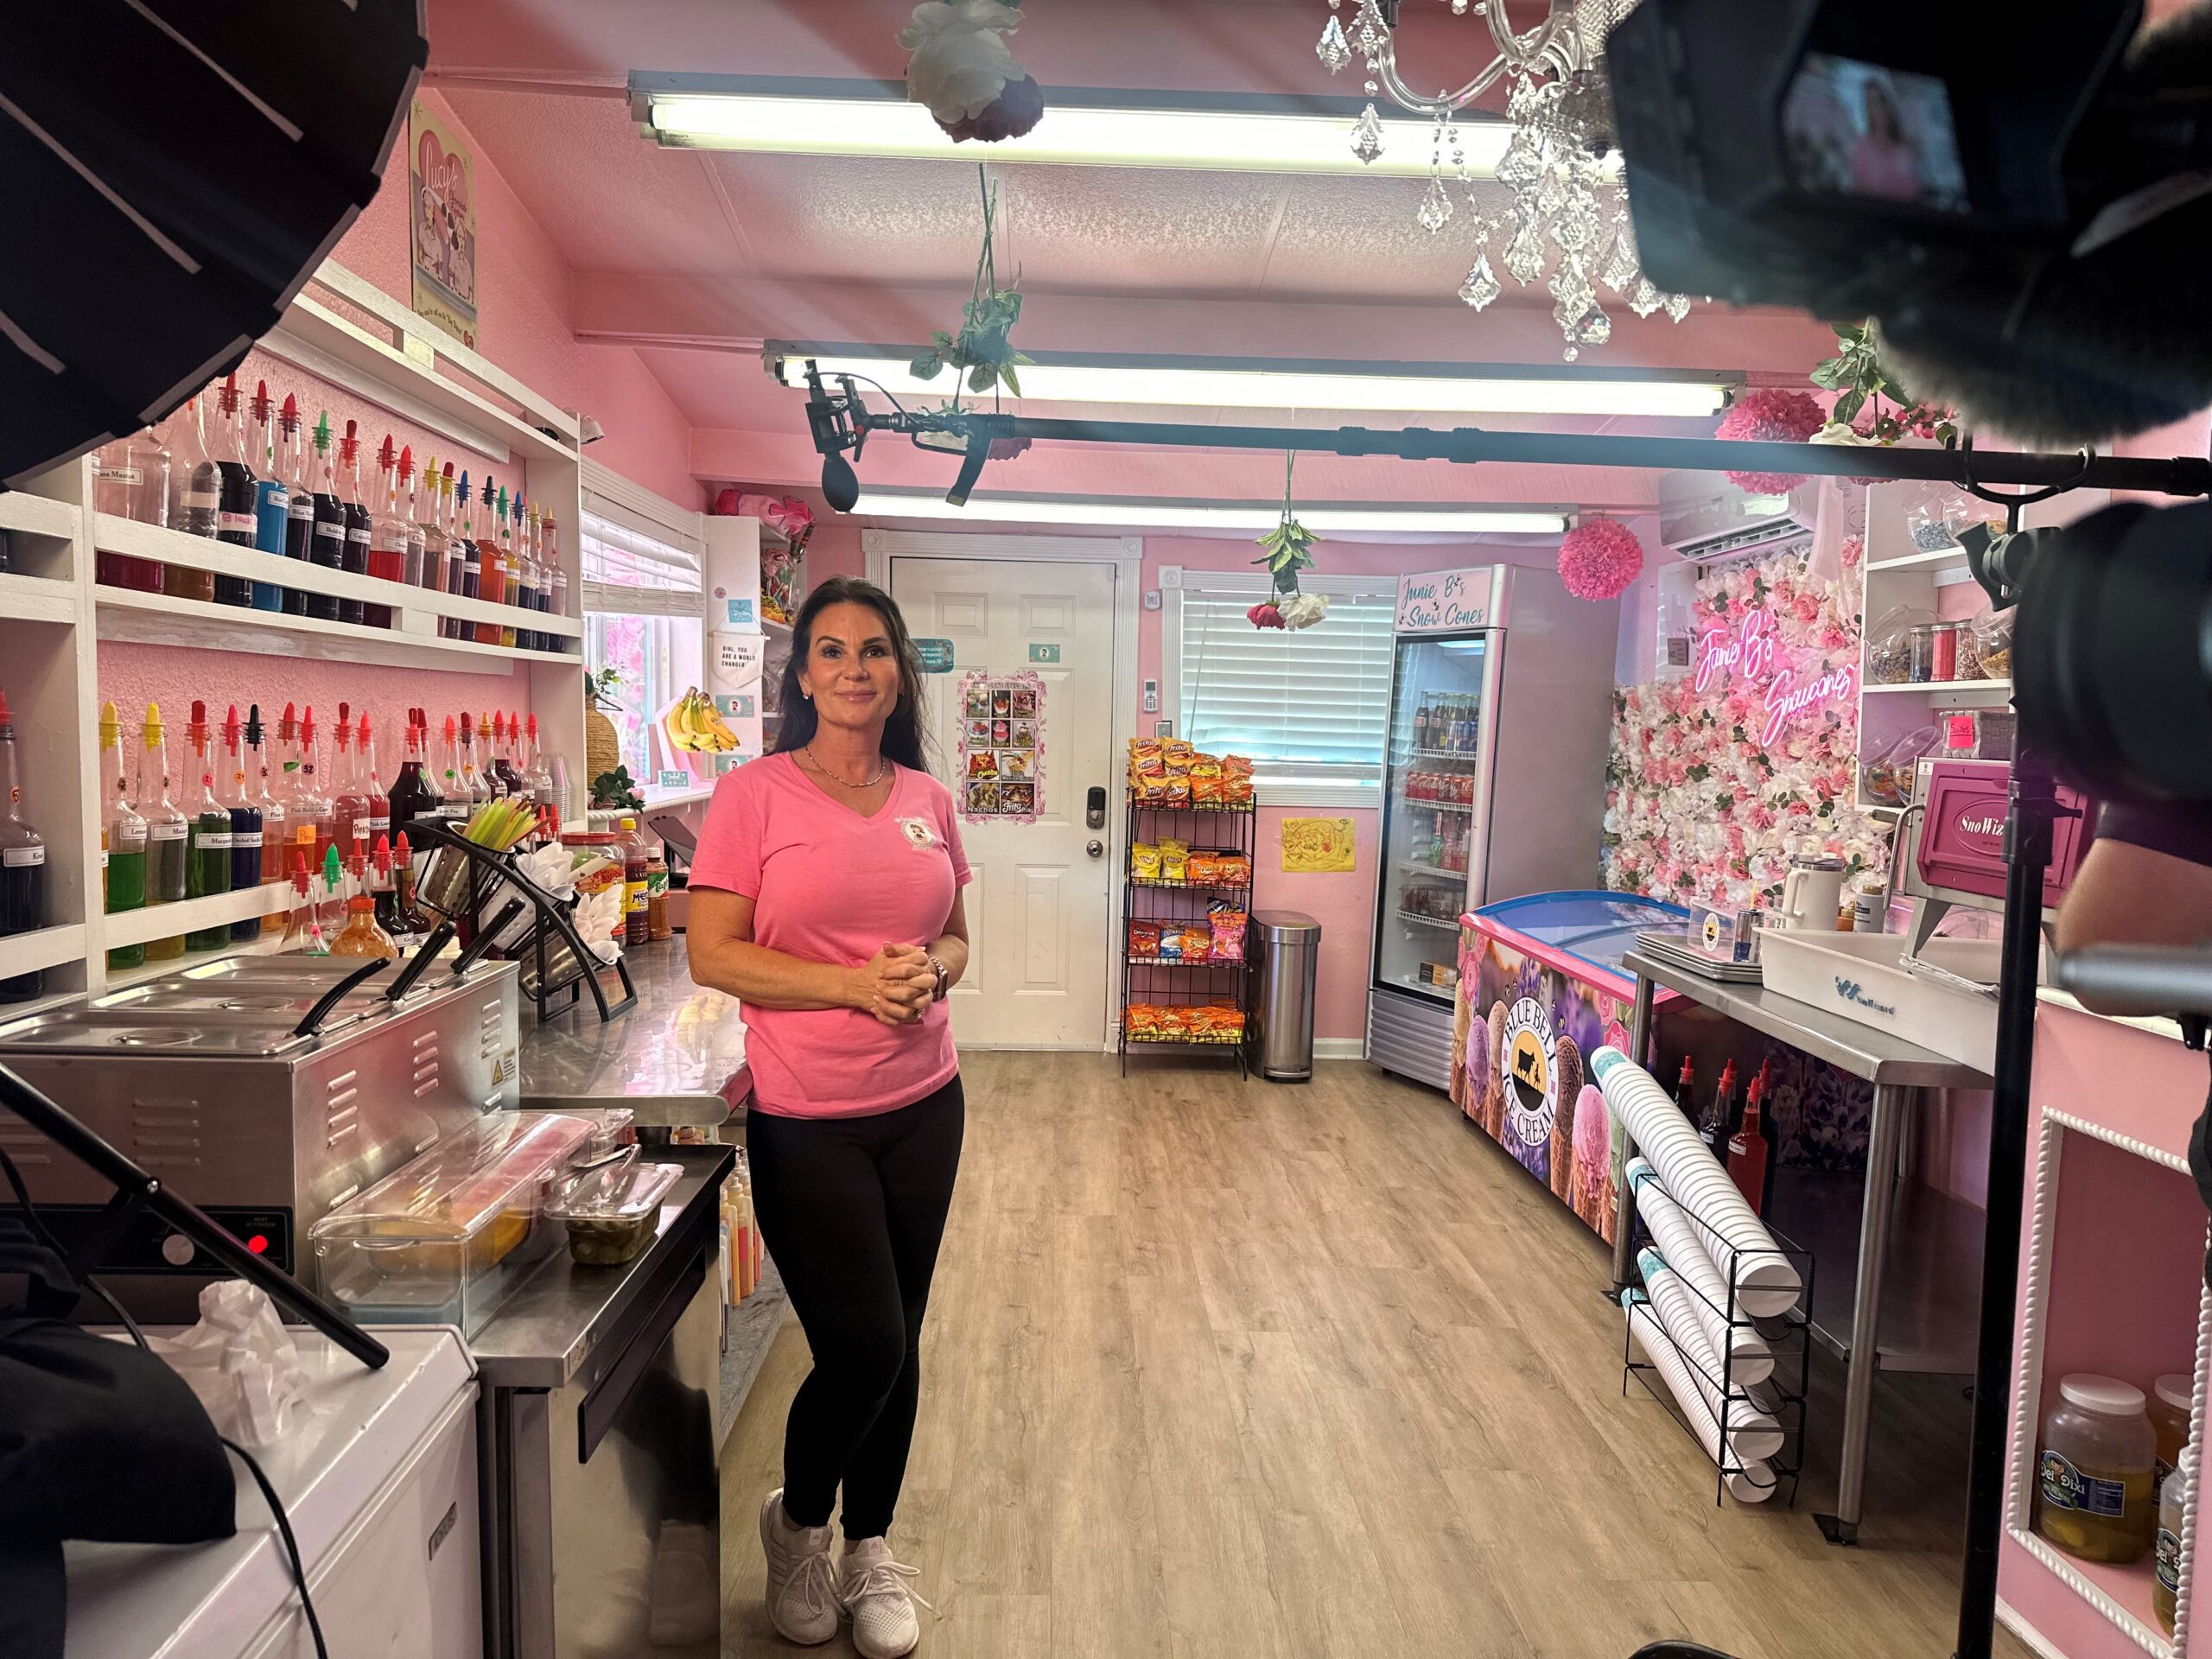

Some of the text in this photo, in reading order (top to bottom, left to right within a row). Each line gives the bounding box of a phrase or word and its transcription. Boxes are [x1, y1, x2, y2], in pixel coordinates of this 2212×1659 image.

[1401, 578, 1437, 610] Junie
[1407, 603, 1484, 626] Snow Cones
[303, 764, 314, 774] 32
[1002, 802, 1021, 813] Frito
[1959, 815, 2005, 836] SnoWiz
[1504, 1000, 1556, 1073] BLUE BELL
[1503, 1073, 1554, 1143] ICE CREAM
